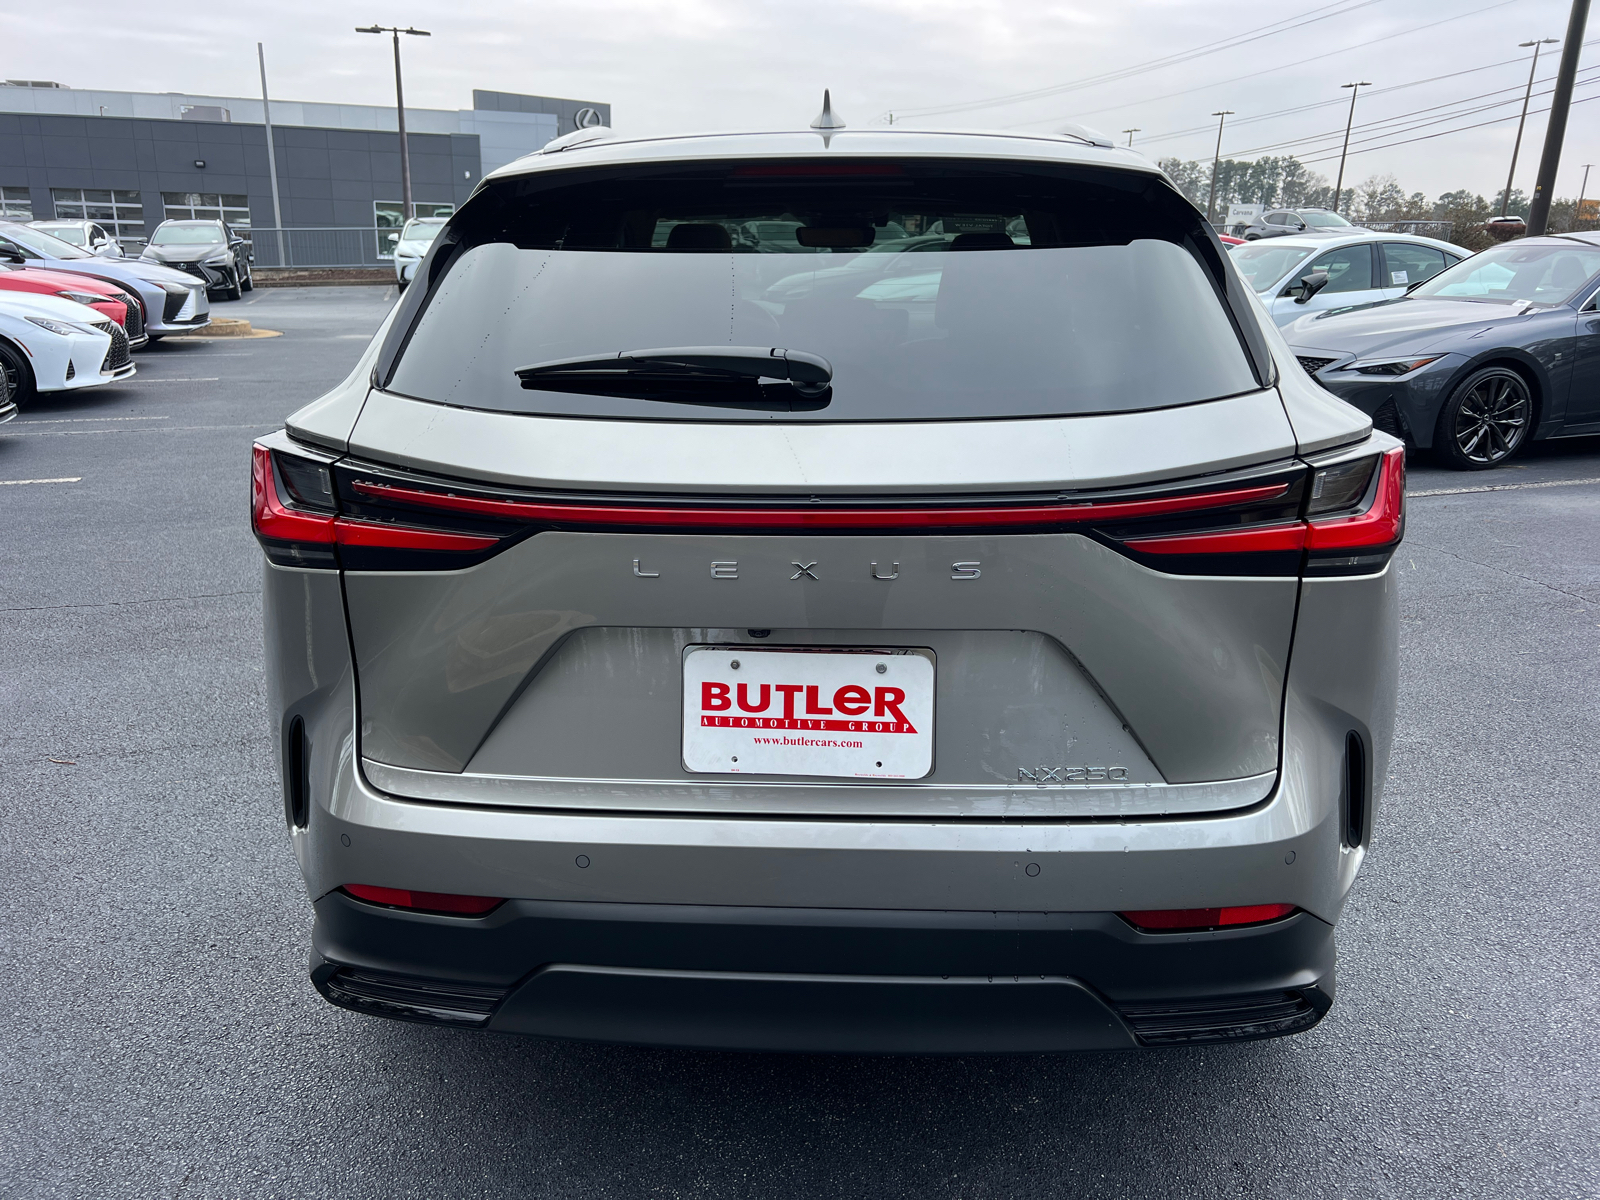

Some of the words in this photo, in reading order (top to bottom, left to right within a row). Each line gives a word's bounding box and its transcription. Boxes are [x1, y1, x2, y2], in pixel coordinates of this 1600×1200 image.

[632, 559, 982, 581] LEXUS
[702, 716, 827, 730] AUTOMOTIVE
[848, 721, 911, 733] GROUP
[753, 736, 863, 749] www.butlercars.com
[1017, 766, 1129, 782] NX250
